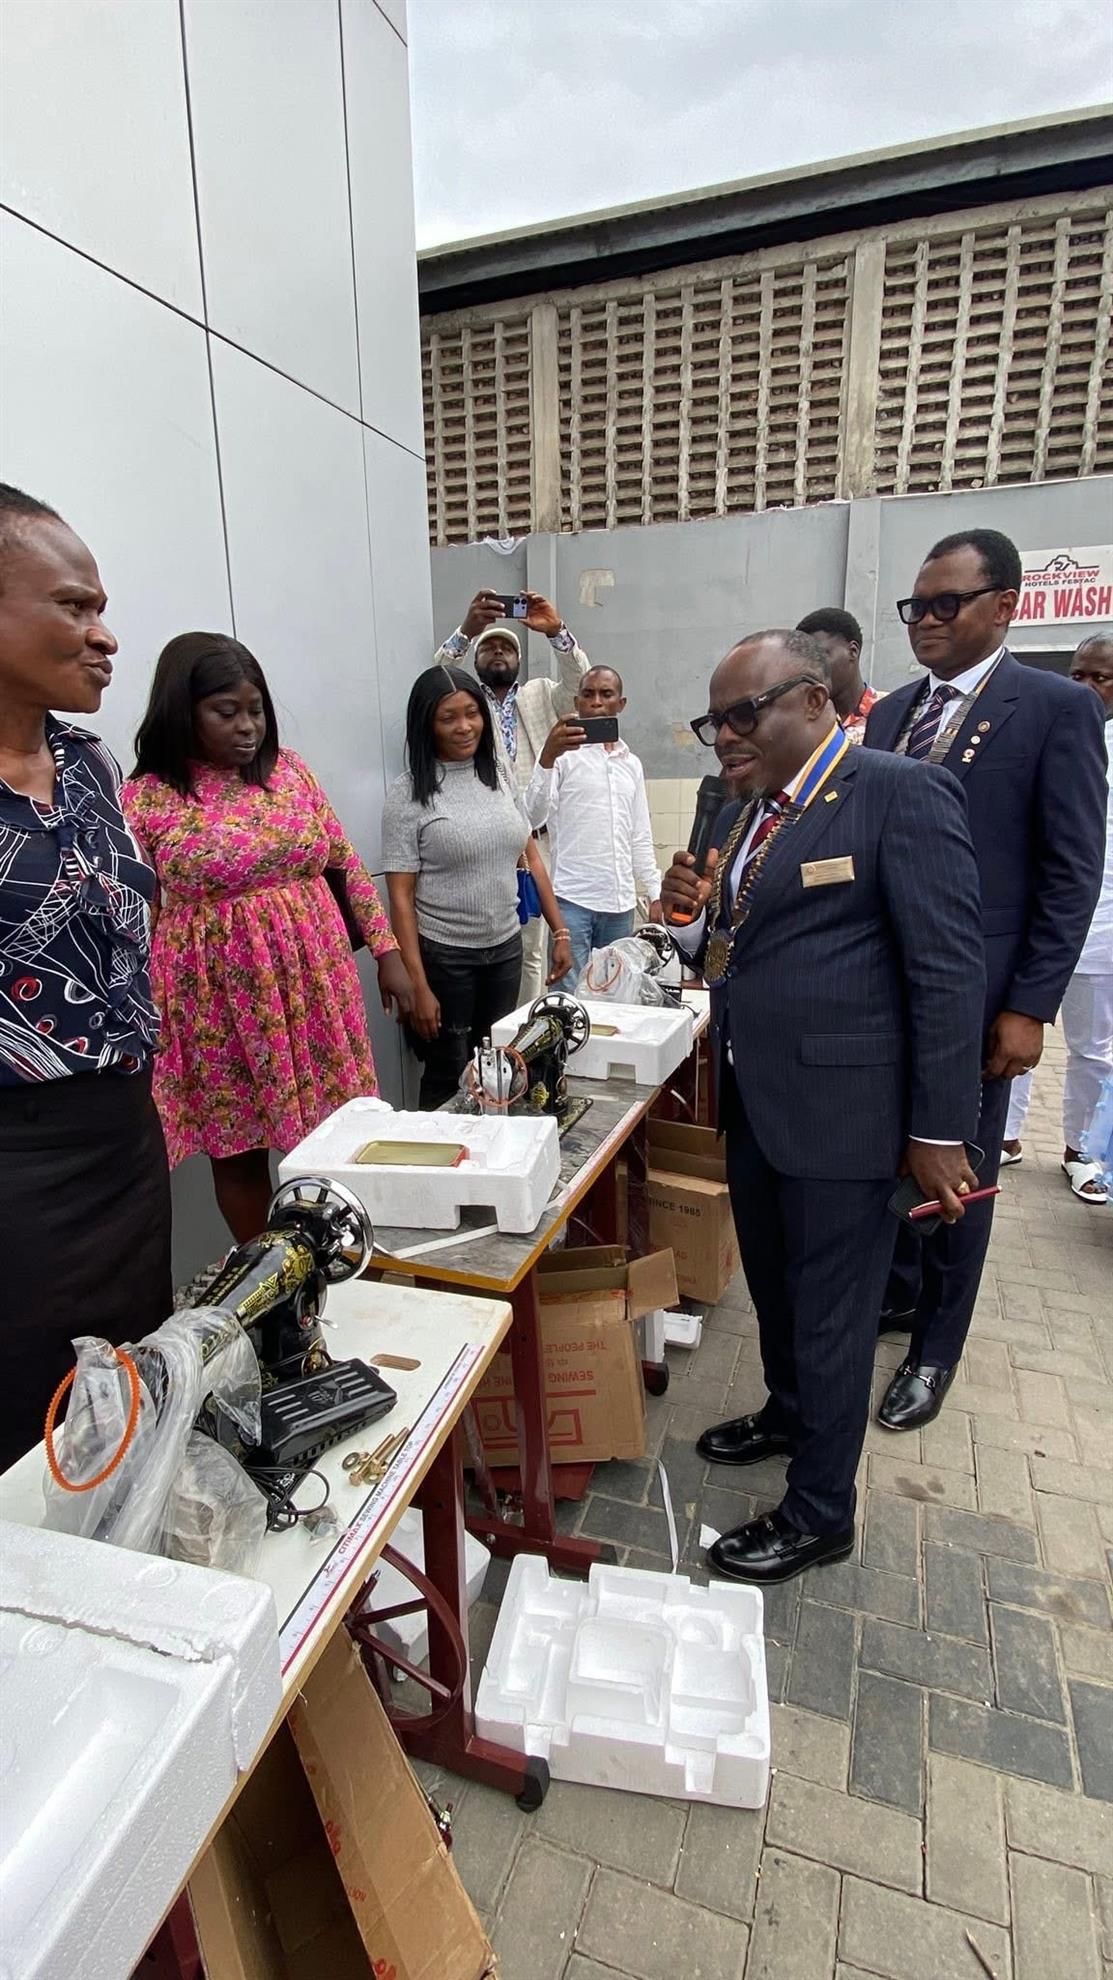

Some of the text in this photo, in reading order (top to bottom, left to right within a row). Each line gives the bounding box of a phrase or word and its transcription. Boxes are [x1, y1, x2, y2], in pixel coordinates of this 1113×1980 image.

[1022, 571, 1099, 581] ROCKVIEW
[1053, 586, 1113, 618] WASH
[587, 1340, 607, 1351] THE
[549, 1370, 594, 1383] SEWING
[338, 1440, 414, 1554] CITIMAX SEWING MACHINE TABLE TOP
